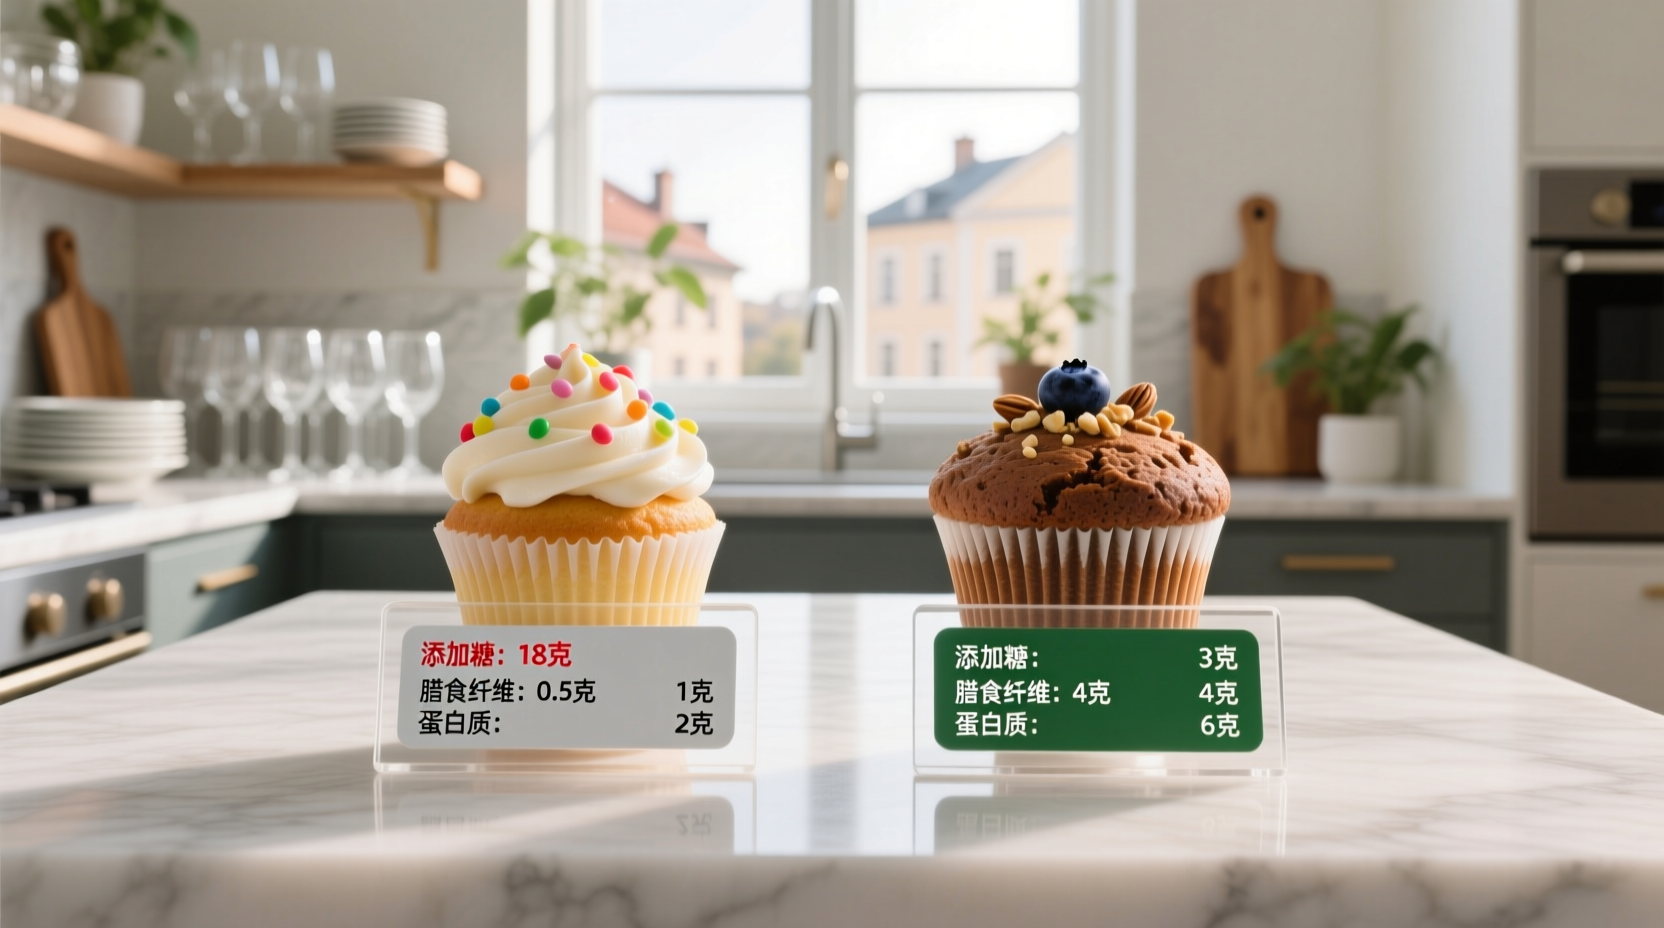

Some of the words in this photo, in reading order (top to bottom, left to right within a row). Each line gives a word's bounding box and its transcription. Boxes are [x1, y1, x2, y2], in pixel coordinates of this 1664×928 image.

[421, 640, 572, 668] 添加糖：18克
[954, 643, 1038, 671] 添加糖：
[1198, 644, 1239, 671] 3克
[676, 678, 714, 704] 1克
[1198, 679, 1239, 706] 4克
[417, 709, 501, 736] 蛋白质：
[674, 710, 714, 736] 2克
[954, 710, 1038, 737] 蛋白质：
[1200, 711, 1241, 738] 6克
